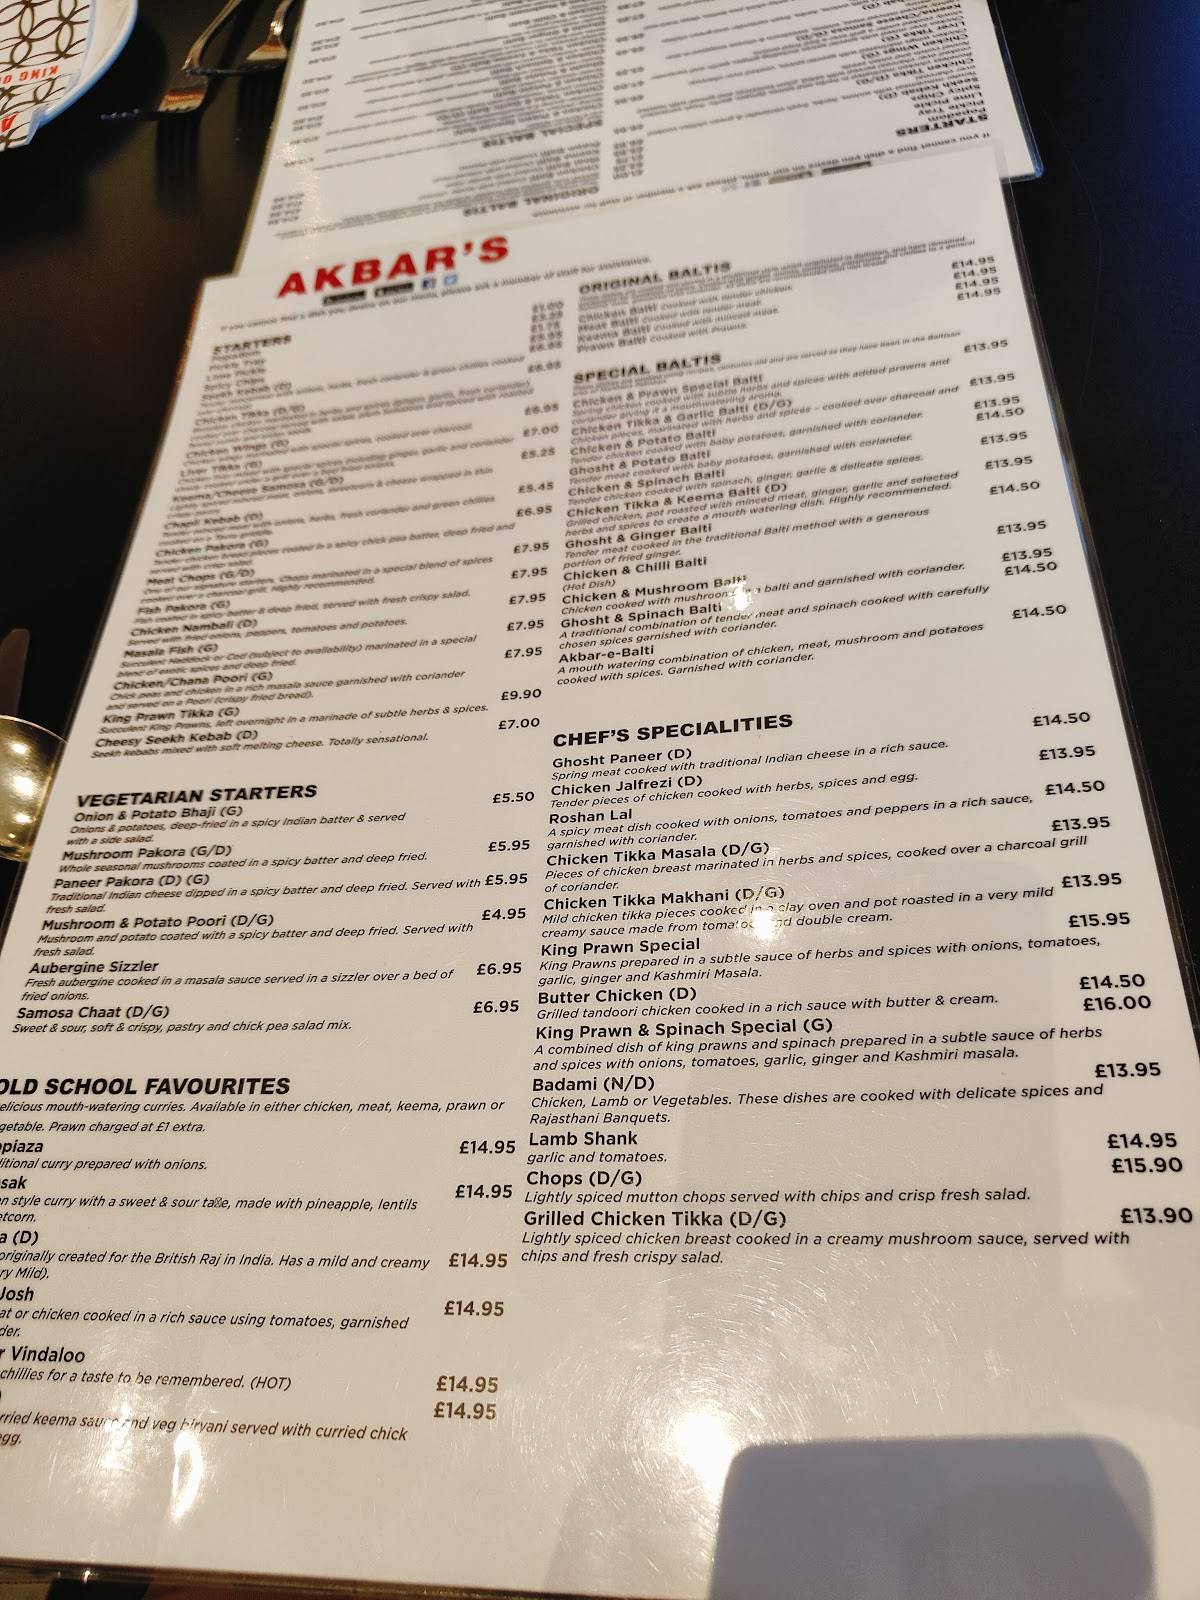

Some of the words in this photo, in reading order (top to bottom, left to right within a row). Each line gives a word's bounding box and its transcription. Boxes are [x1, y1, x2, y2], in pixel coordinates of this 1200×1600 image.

[20, 65, 58, 81] KING
[896, 113, 988, 137] STARTERS
[277, 235, 510, 299] AKBAR'S
[951, 256, 995, 269] £14.95
[579, 272, 663, 295] ORIGINAL
[668, 261, 731, 281] BALTIS
[953, 266, 997, 279] £14.95
[954, 276, 999, 290] £14.95
[956, 286, 1001, 300] £14.95
[963, 339, 1008, 353] £13.95
[573, 364, 649, 384] SPECIAL
[655, 352, 721, 373] BALTIS
[969, 372, 1015, 386] £13.95
[524, 402, 559, 416] £6.95
[973, 395, 1020, 409] £13.95
[975, 407, 1024, 421] £14.50
[522, 424, 559, 437] £7.00
[980, 430, 1028, 445] £13.95
[520, 446, 555, 460] £5.25
[985, 455, 1033, 469] £13.95
[517, 481, 554, 493] £5.45
[989, 480, 1040, 495] £14.50
[566, 504, 619, 518] Chicken
[623, 499, 659, 510] Tikka
[663, 496, 672, 506] &
[676, 491, 724, 504] Keema
[728, 485, 759, 497] Balti
[764, 482, 787, 494] (D)
[516, 504, 552, 517] £6.95
[996, 519, 1047, 534] £13.95
[512, 541, 549, 554] £7.95
[1001, 547, 1053, 562] £13.95
[511, 566, 547, 579] £7.95
[1004, 560, 1058, 576] £14.50
[561, 581, 586, 593] (Hot
[588, 578, 616, 589] Dish)
[508, 592, 546, 605] £7.95
[1011, 604, 1067, 619] £14.50
[506, 618, 544, 631] £7.95
[504, 646, 542, 658] £7.95
[558, 644, 654, 663] Akbar-e-Balti
[556, 673, 598, 685] cooked
[600, 671, 623, 681] with
[625, 669, 663, 680] spices.
[667, 661, 726, 675] Garnished
[728, 658, 753, 669] with
[756, 652, 814, 666] coriander.
[500, 688, 542, 701] £9.90
[102, 714, 132, 724] King
[135, 712, 175, 721] Prawn
[180, 708, 214, 718] Tikka
[217, 706, 240, 717] (G)
[1032, 711, 1091, 727] £14.50
[498, 717, 540, 730] £7.00
[552, 728, 630, 747] CHEF'S
[636, 713, 793, 741] SPECIALITIES
[94, 737, 141, 748] Cheesy
[145, 733, 185, 745] Seekh
[189, 731, 232, 742] Kebab
[235, 729, 258, 741] (D)
[552, 754, 605, 768] Ghosht
[609, 751, 663, 764] Paneer
[667, 747, 692, 761] (D)
[1038, 745, 1096, 761] £13.95
[550, 782, 610, 796] Chicken
[615, 776, 672, 792] Jalfrezi
[677, 774, 703, 788] (D)
[1044, 779, 1105, 796] £14.50
[77, 789, 204, 808] VEGETARIAN
[208, 784, 317, 802] STARTERS
[492, 791, 535, 804] £5.50
[549, 811, 605, 824] Roshan
[610, 807, 632, 821] Lal
[1051, 815, 1110, 831] £13.95
[487, 839, 530, 852] £5.95
[546, 852, 608, 866] Chicken
[613, 849, 656, 862] Tikka
[661, 845, 716, 860] Masala
[721, 841, 770, 858] (D/G)
[484, 872, 528, 886] £5.95
[1061, 872, 1122, 888] £13.95
[481, 907, 526, 921] £4.95
[1068, 911, 1130, 928] £15.95
[541, 943, 577, 958] King
[583, 942, 633, 955] Prawn
[639, 937, 700, 954] Special
[28, 960, 105, 975] Aubergine
[108, 959, 159, 973] Sizzler
[476, 961, 522, 975] £6.95
[1079, 973, 1145, 990] £14.50
[20, 991, 50, 1001] fried
[50, 991, 89, 1001] onions.
[538, 991, 590, 1005] Butter
[595, 987, 663, 1002] Chicken
[669, 986, 696, 1002] (D)
[1082, 995, 1151, 1012] £16.00
[16, 1007, 74, 1019] Samosa
[77, 1006, 122, 1018] Chaat
[125, 1003, 170, 1019] (D/G)
[472, 999, 519, 1014] £6.95
[1094, 1061, 1161, 1078] £13.95
[43, 1077, 137, 1095] SCHOOL
[144, 1077, 290, 1095] FAVOURITES
[532, 1076, 597, 1092] Badami
[603, 1074, 655, 1093] (N/D)
[529, 1112, 600, 1126] Rajasthani
[602, 1111, 671, 1126] Banquets.
[48, 1121, 86, 1132] Prawn
[88, 1120, 140, 1134] charged
[140, 1121, 154, 1132] at
[154, 1121, 171, 1132] £1
[172, 1121, 205, 1132] extra.
[528, 1131, 578, 1146] Lamb
[583, 1130, 638, 1146] Shank
[1107, 1132, 1177, 1149] £14.95
[459, 1139, 516, 1154] £14.95
[526, 1151, 566, 1165] garlic
[568, 1151, 596, 1163] and
[599, 1151, 667, 1163] tomatoes.
[1111, 1156, 1183, 1173] £15.90
[526, 1170, 583, 1188] Chops
[589, 1168, 642, 1188] (D/G)
[455, 1184, 512, 1199] £14.95
[523, 1210, 584, 1226] Grilled
[590, 1210, 665, 1226] Chicken
[671, 1210, 723, 1226] Tikka
[729, 1209, 786, 1229] (D/G)
[1120, 1207, 1193, 1224] £13.90
[448, 1252, 508, 1268] £14.95
[443, 1300, 504, 1317] £14.95
[11, 1345, 85, 1363] Vindaloo
[435, 1375, 498, 1394] £14.95
[433, 1401, 496, 1420] £14.95
